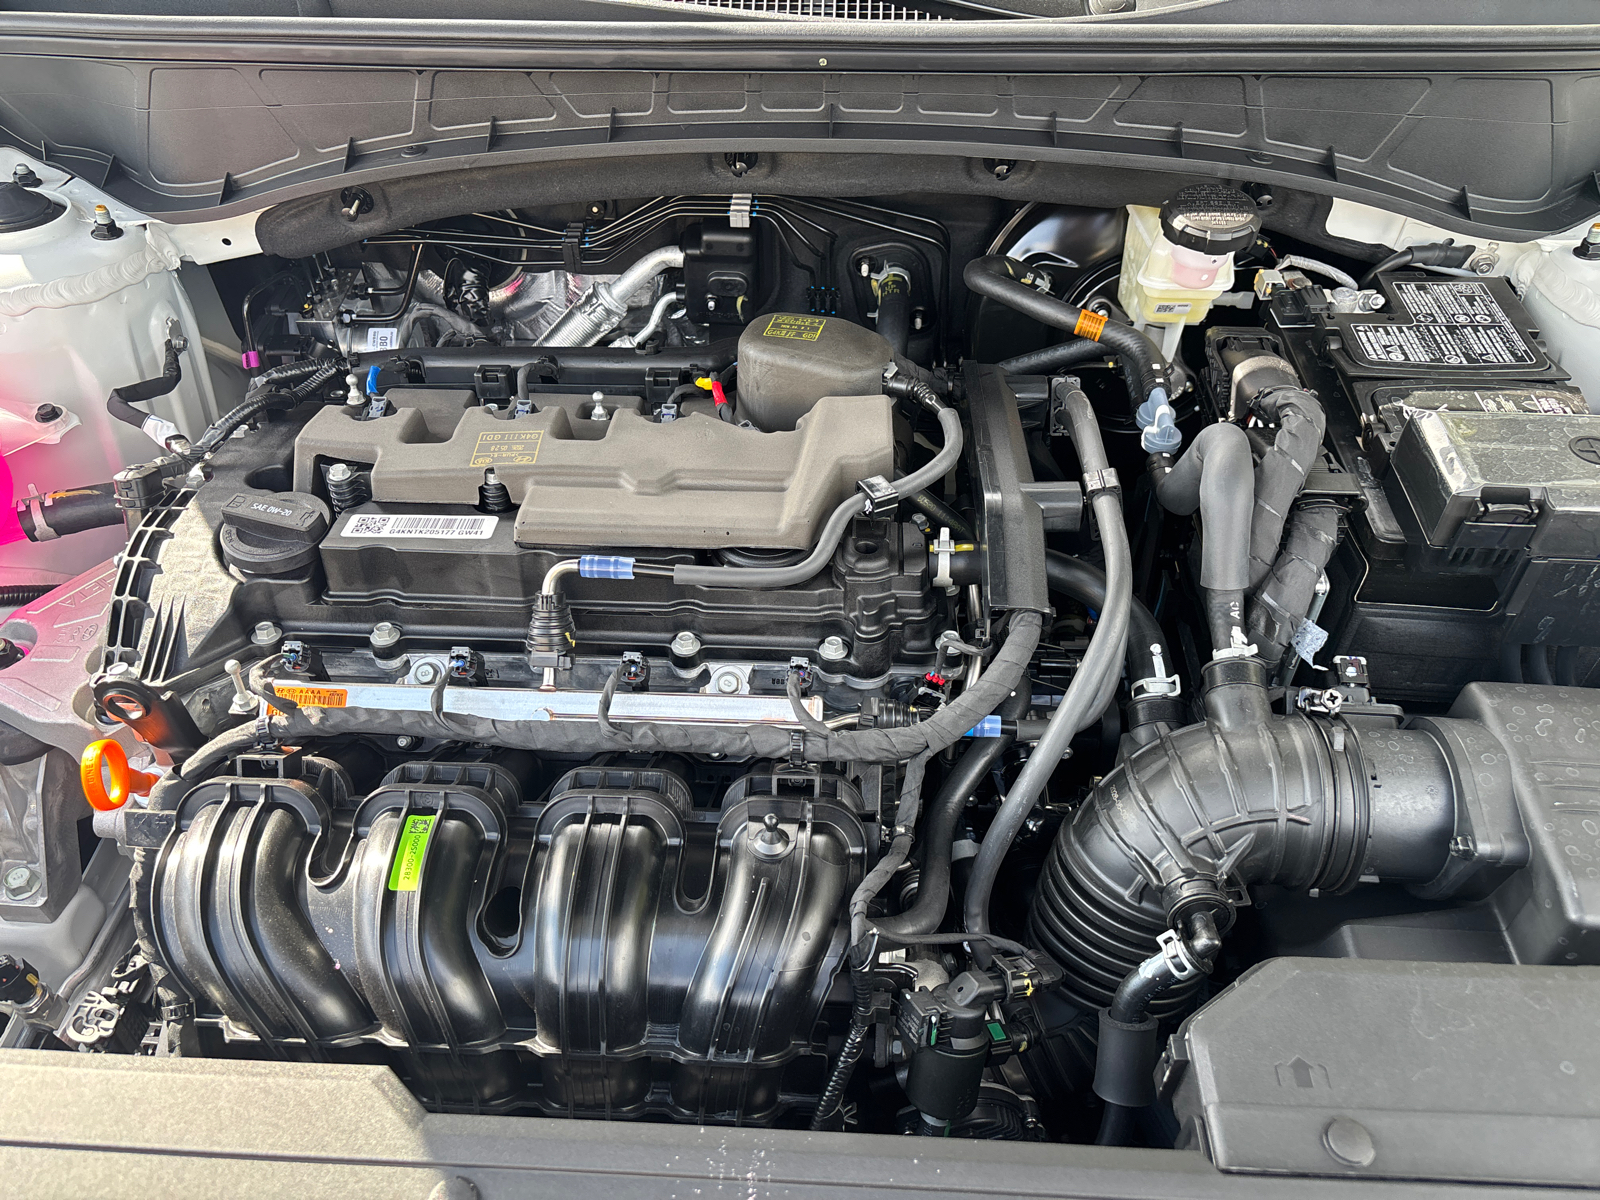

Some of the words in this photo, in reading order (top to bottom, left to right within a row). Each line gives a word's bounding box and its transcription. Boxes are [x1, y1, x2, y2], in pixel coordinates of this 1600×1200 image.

[250, 502, 267, 512] SAE
[266, 506, 292, 516] 0W-20
[226, 528, 234, 544] OPEN
[1230, 601, 1240, 620] AC
